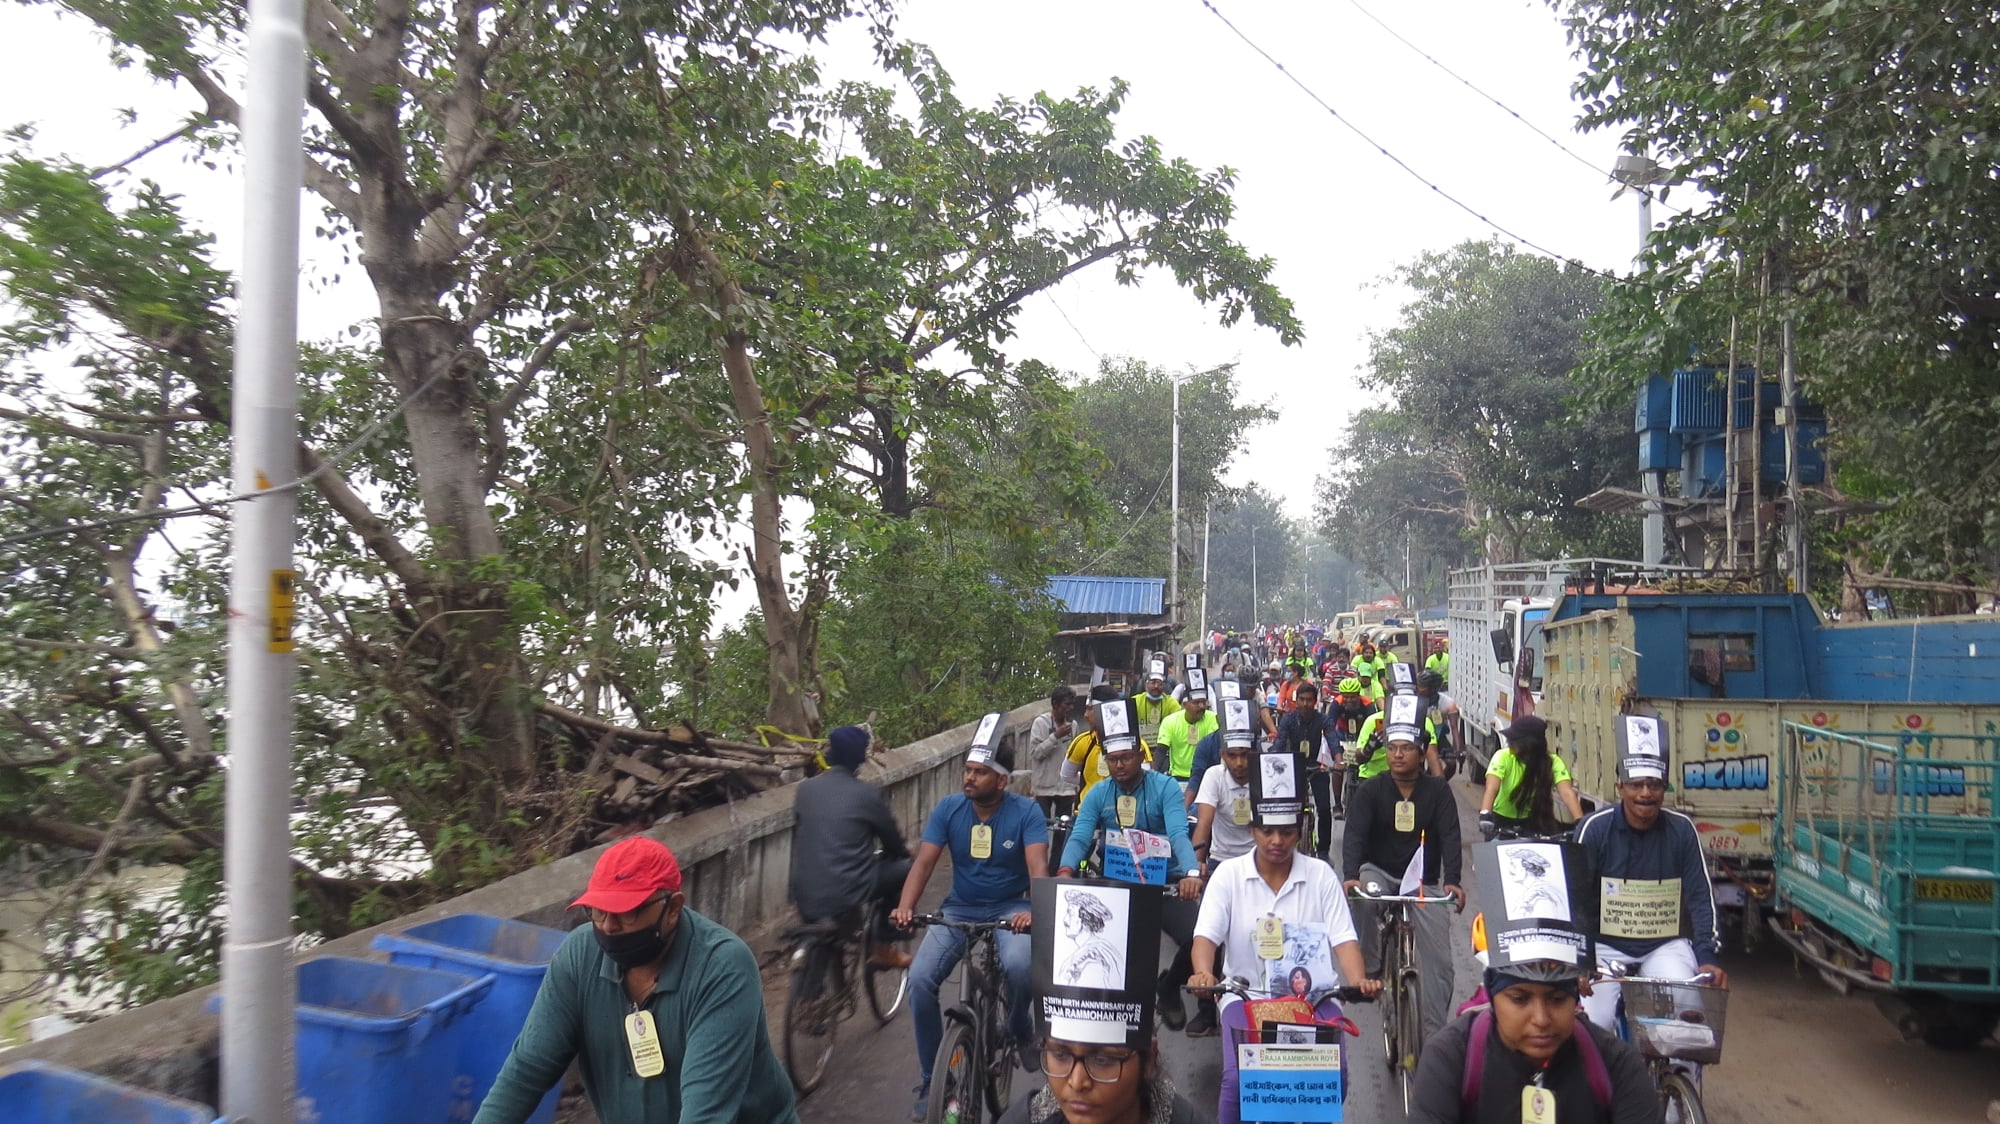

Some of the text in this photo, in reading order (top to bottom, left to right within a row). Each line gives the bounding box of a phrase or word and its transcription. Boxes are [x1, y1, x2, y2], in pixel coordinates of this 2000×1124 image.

[1683, 755, 1768, 790] BLOW
[1709, 836, 1740, 849] OBEY
[1062, 998, 1080, 1008] BIRTH
[1080, 1000, 1125, 1010] ANNIVERSARY
[1126, 1003, 1135, 1011] OF
[1048, 1005, 1134, 1022] RAJA RAMMOHAN ROY
